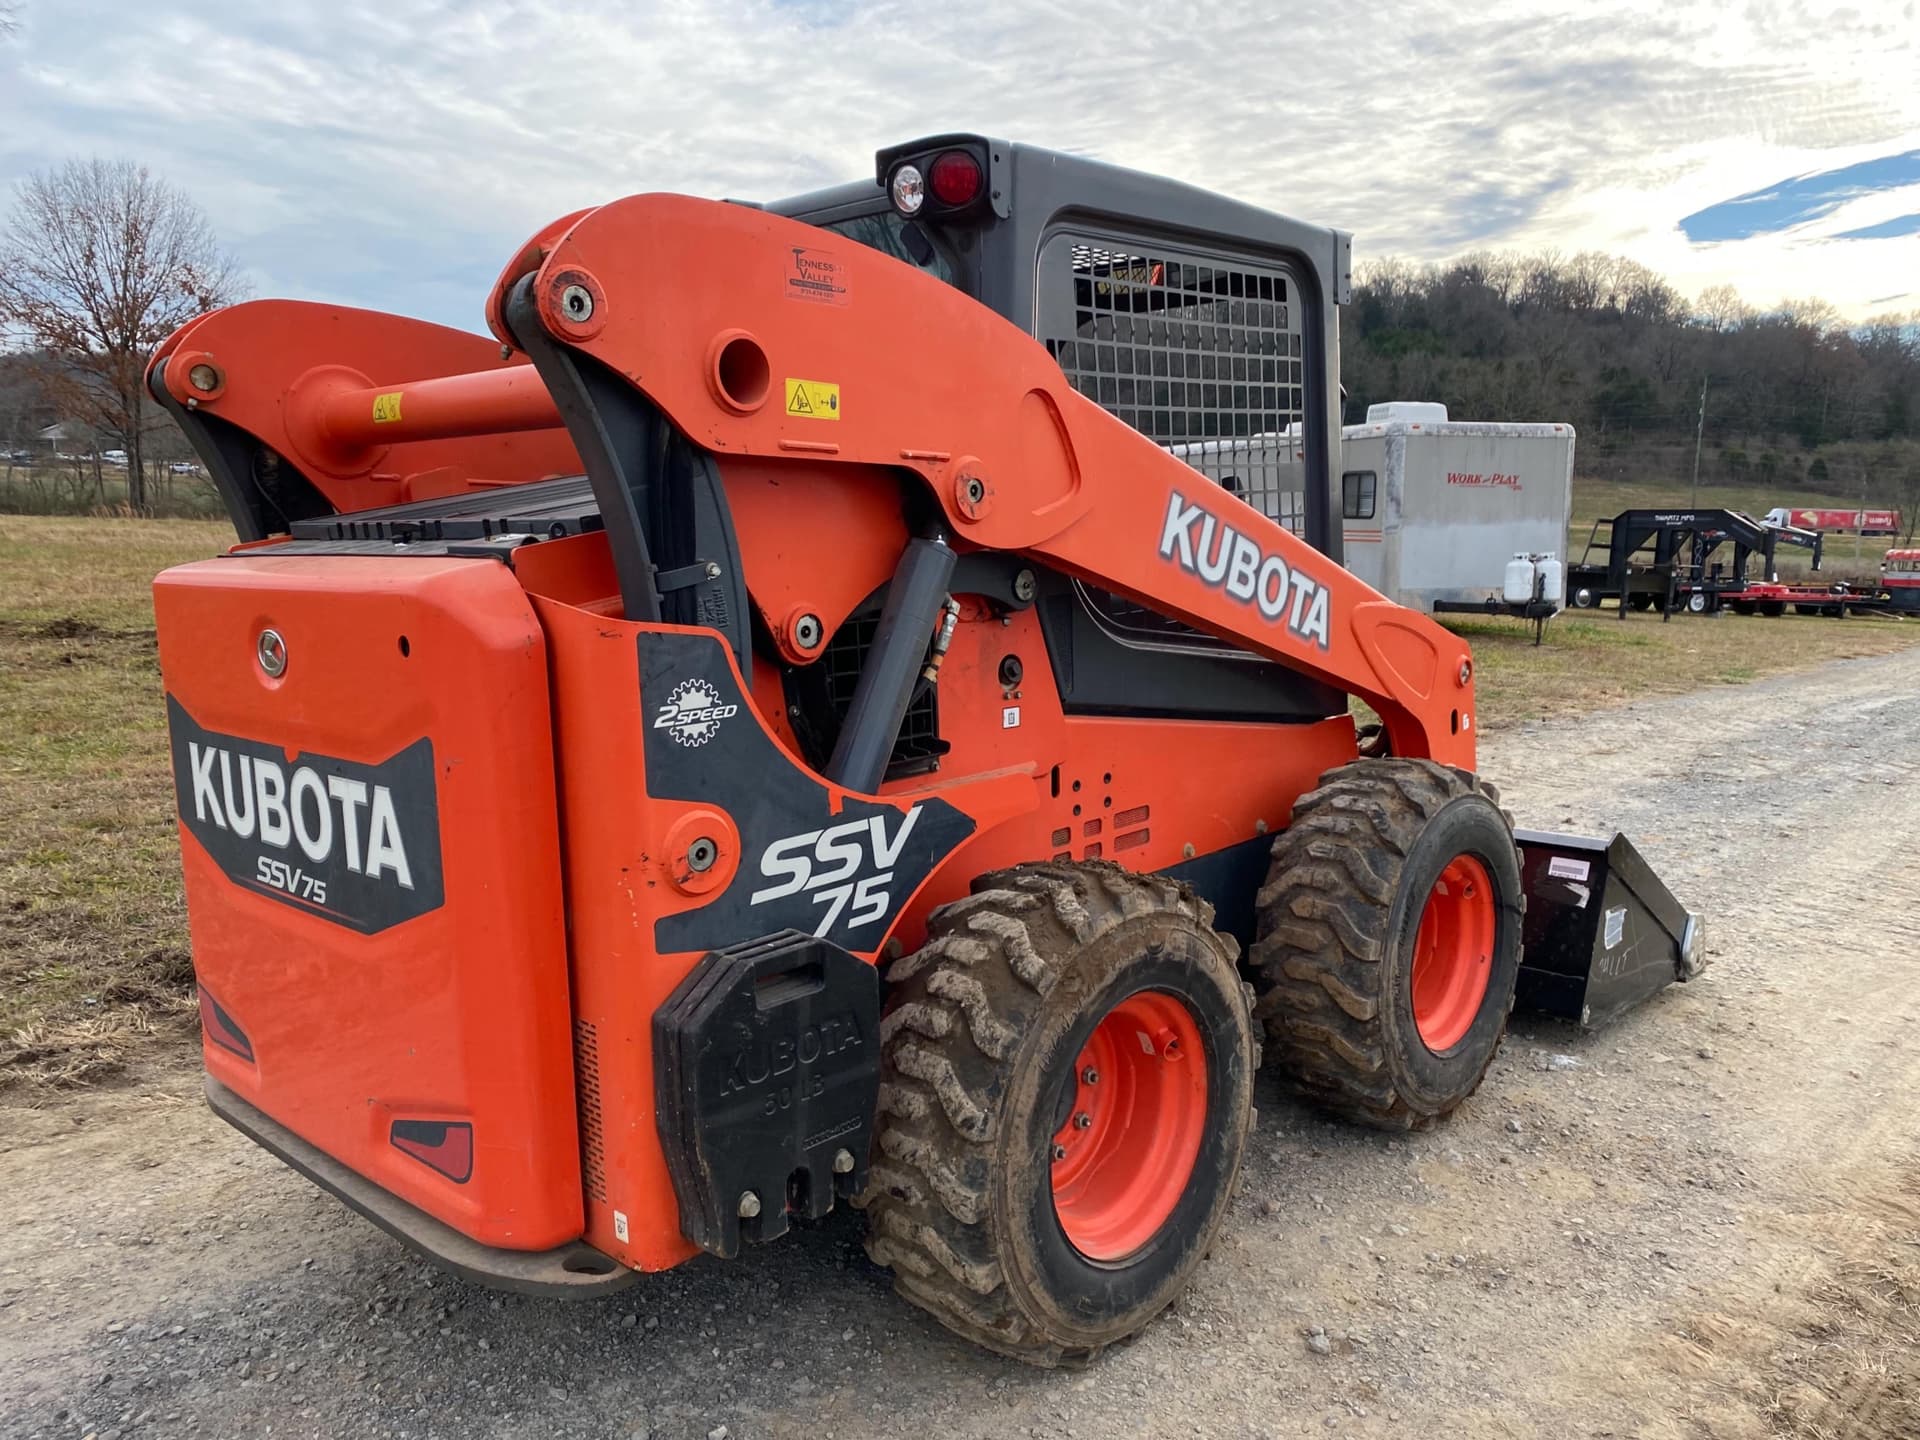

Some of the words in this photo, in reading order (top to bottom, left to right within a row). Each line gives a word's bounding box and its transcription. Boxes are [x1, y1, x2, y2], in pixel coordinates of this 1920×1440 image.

[792, 248, 845, 272] TENNESS
[799, 267, 833, 284] VALLEY
[1447, 472, 1482, 484] WORK
[1491, 473, 1520, 484] PLAY
[1160, 490, 1330, 650] KUBOTA
[188, 741, 415, 891] KUBOTA
[751, 805, 923, 906] SSV
[812, 872, 894, 938] 75
[720, 1009, 863, 1097] KUBOTA
[764, 1086, 791, 1116] 50
[800, 1072, 825, 1101] LB
